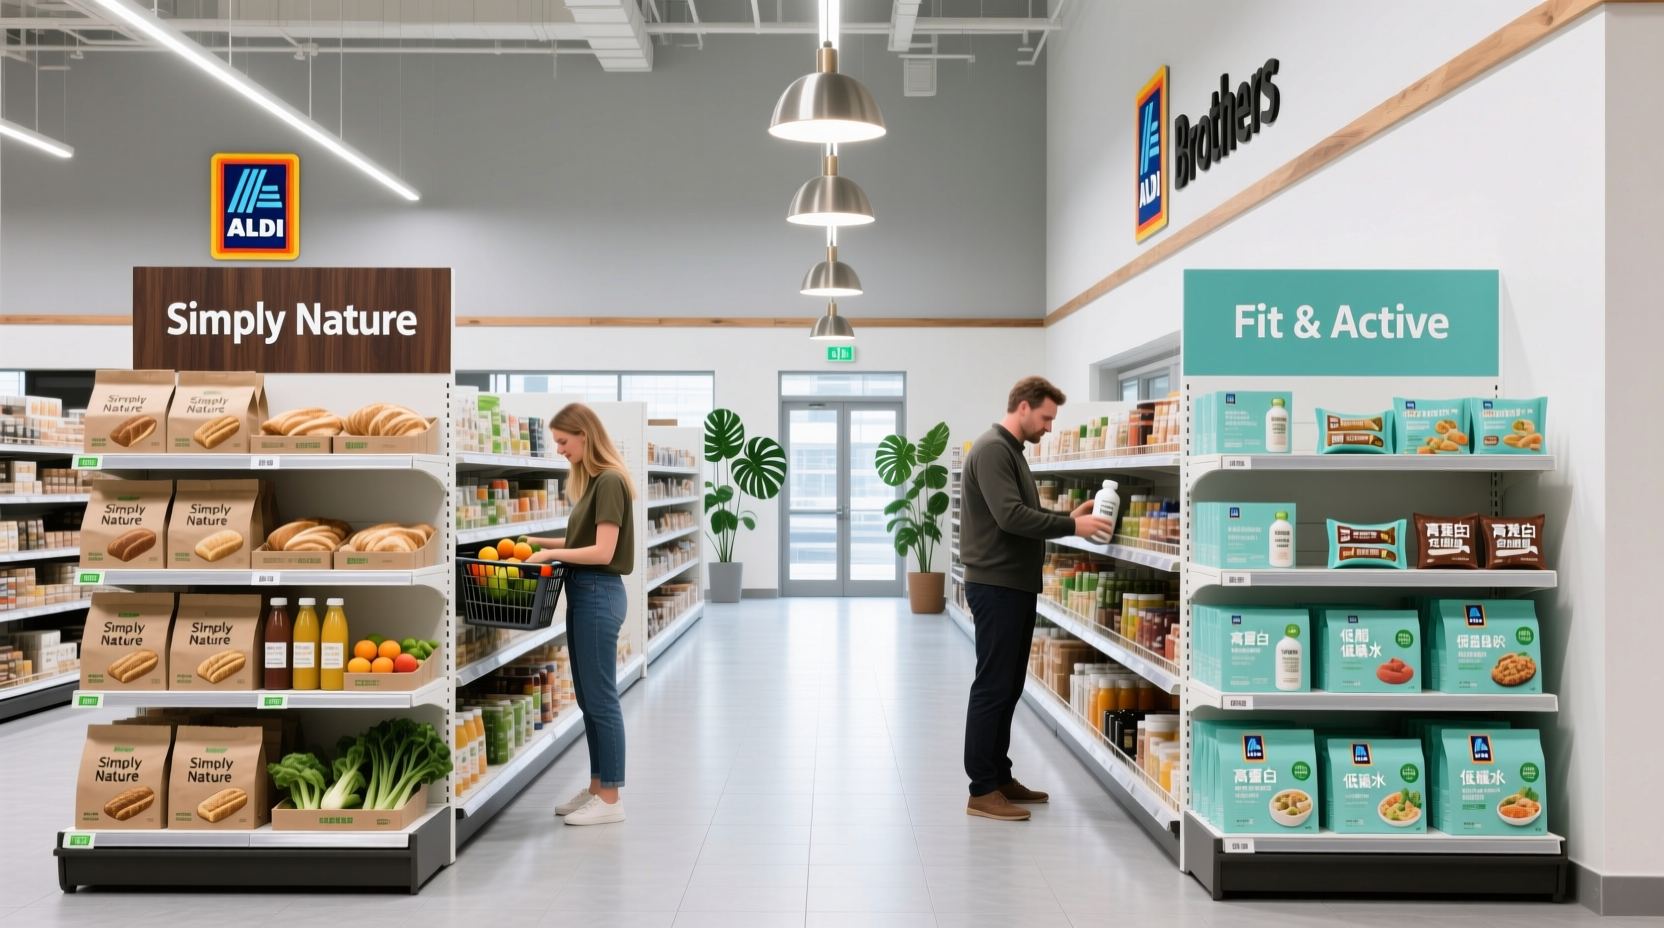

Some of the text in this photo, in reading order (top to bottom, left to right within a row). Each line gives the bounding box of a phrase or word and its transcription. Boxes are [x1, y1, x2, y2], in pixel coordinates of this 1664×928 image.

[1174, 58, 1280, 191] Brothers
[1139, 171, 1160, 208] ALDI
[226, 218, 284, 238] ALDI
[166, 300, 418, 345] Simply Nature
[1235, 302, 1450, 340] Fit & Active
[104, 503, 146, 516] Simply
[189, 503, 231, 516] Simply
[101, 515, 142, 526] Nature
[187, 515, 228, 526] Nature
[103, 621, 146, 635] Simply
[100, 635, 143, 646] Nature
[189, 635, 231, 646] Nature
[98, 756, 142, 771] Simply
[189, 757, 233, 772] Simply
[95, 769, 140, 782] Nature
[187, 770, 232, 783] Nature
